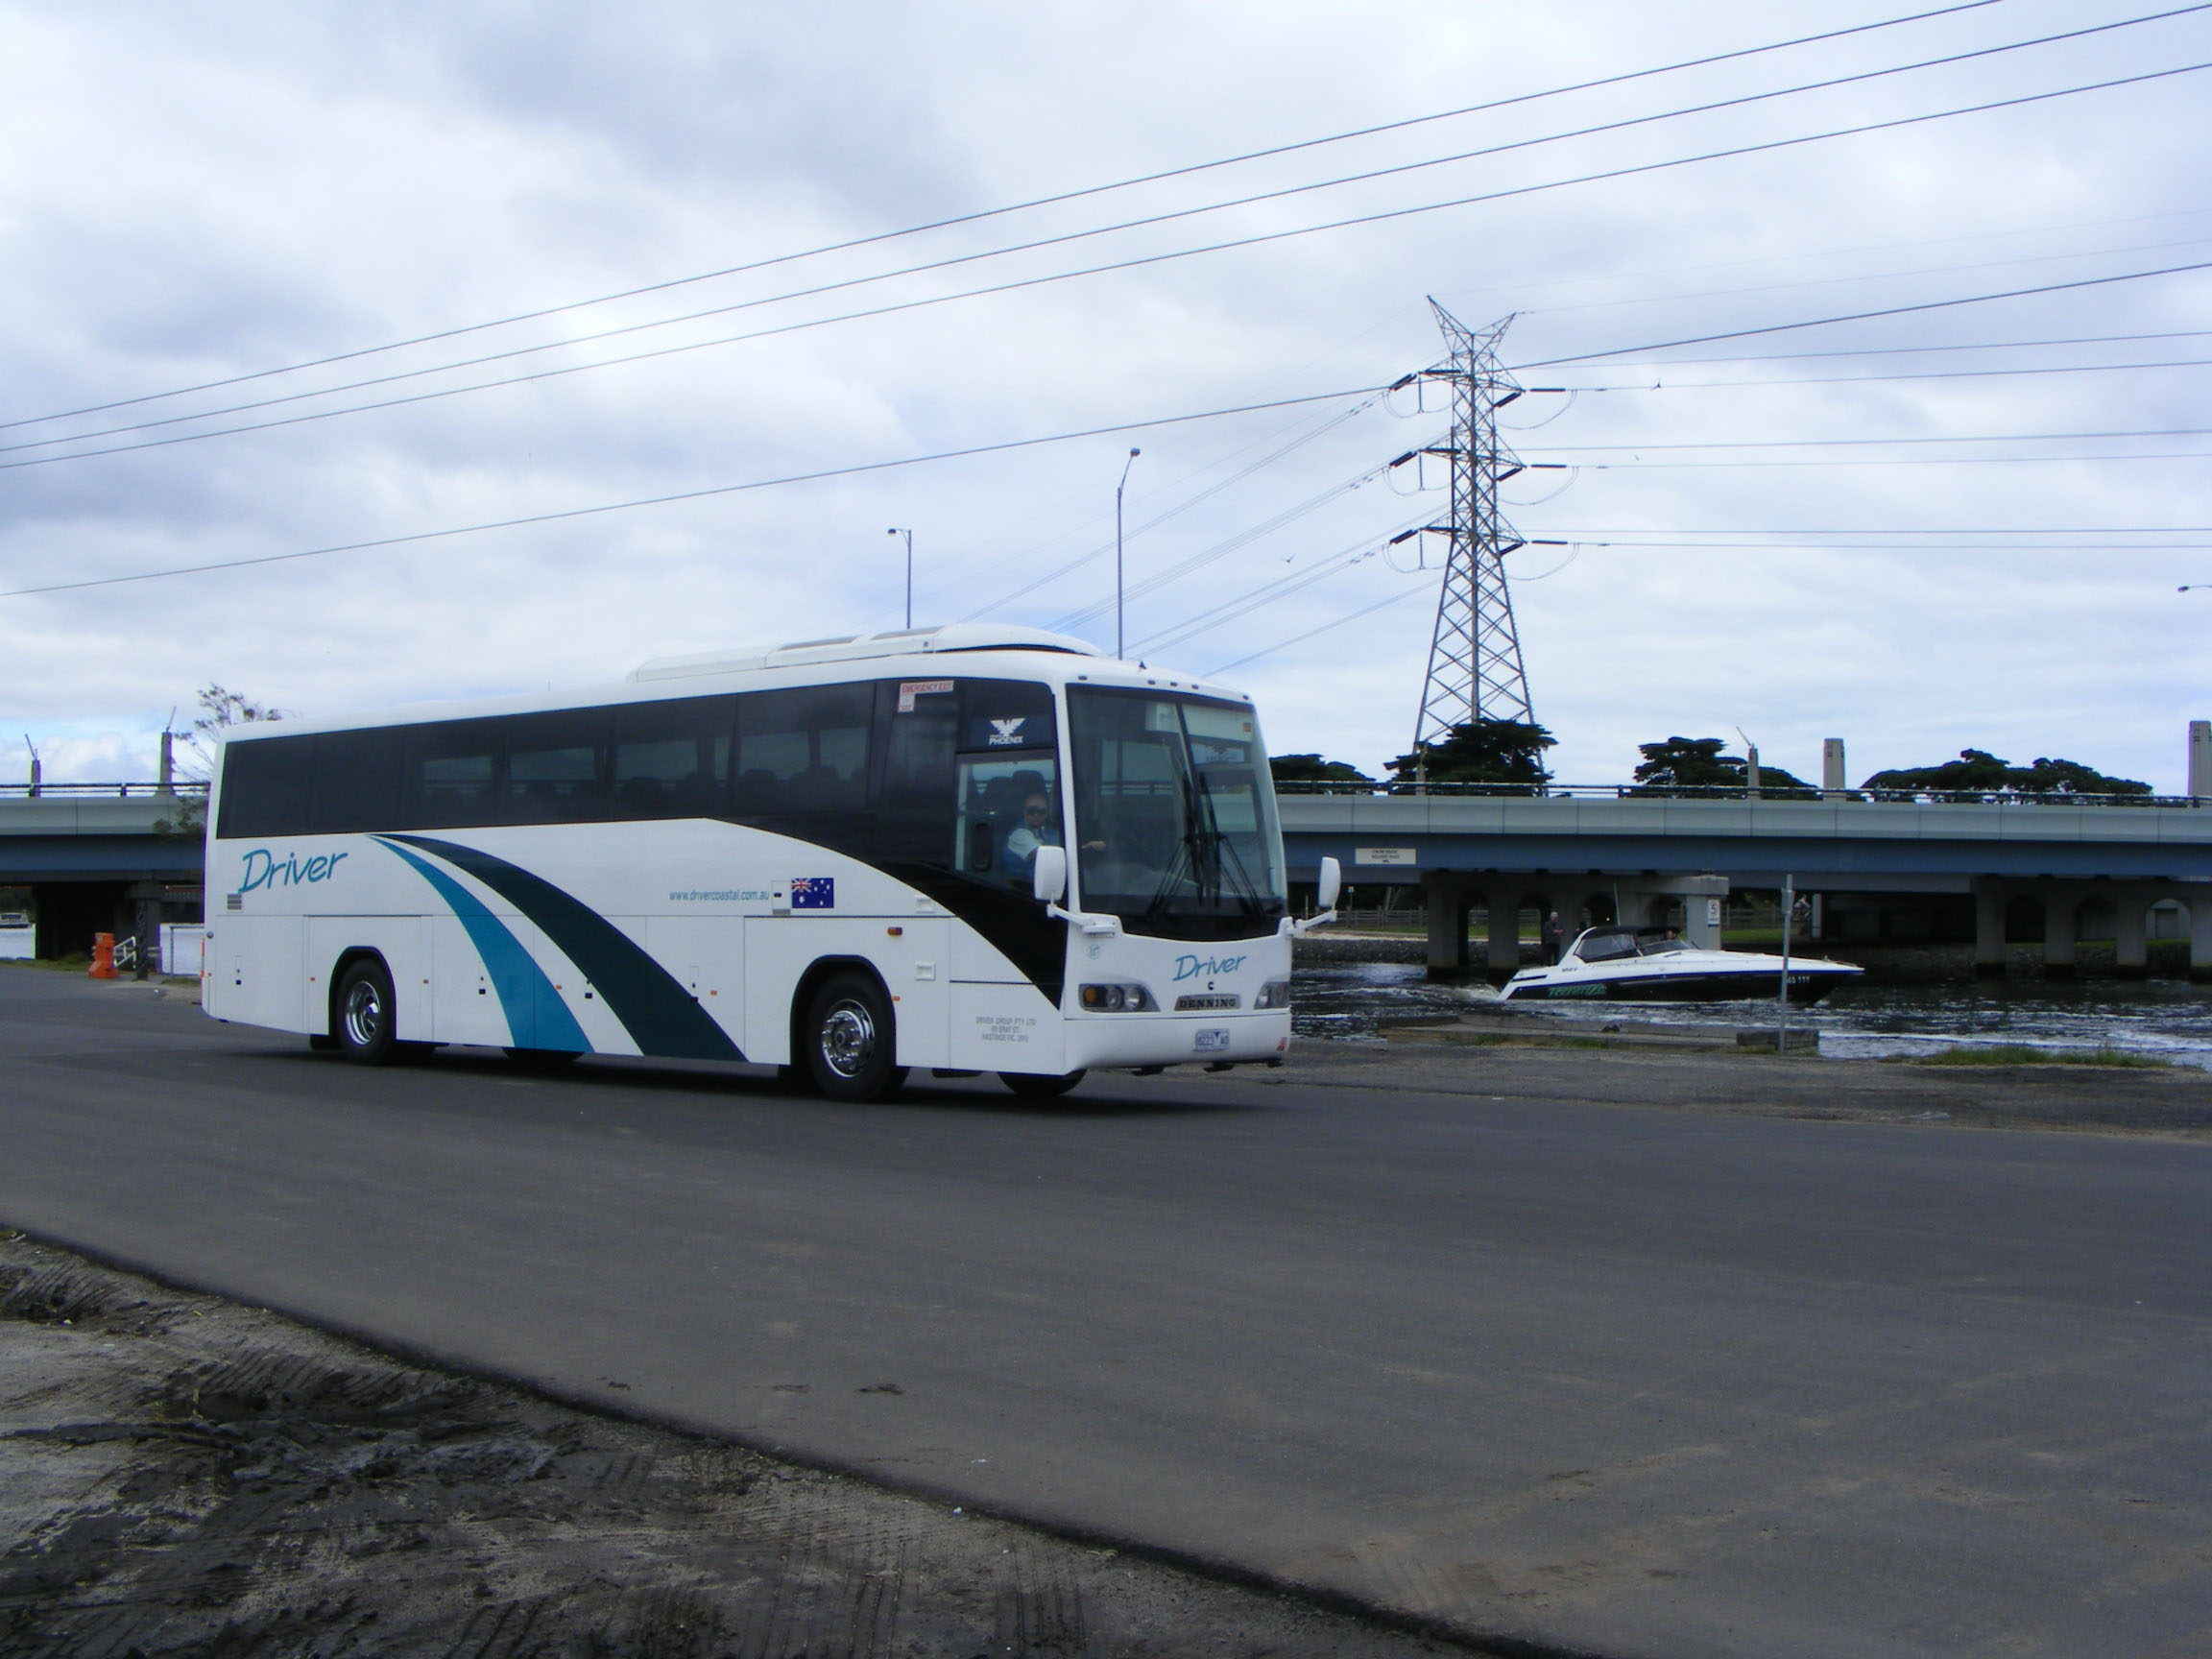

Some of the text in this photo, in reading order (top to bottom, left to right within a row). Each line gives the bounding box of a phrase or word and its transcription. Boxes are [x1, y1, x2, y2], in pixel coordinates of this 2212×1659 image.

[902, 680, 953, 693] EMERGENCY EXIT
[989, 736, 1022, 746] PHOENIX
[238, 849, 349, 894] Driver
[669, 889, 770, 901] www.drivercoastal.com.au
[1172, 954, 1247, 981] Driver
[1179, 998, 1237, 1009] DENNING
